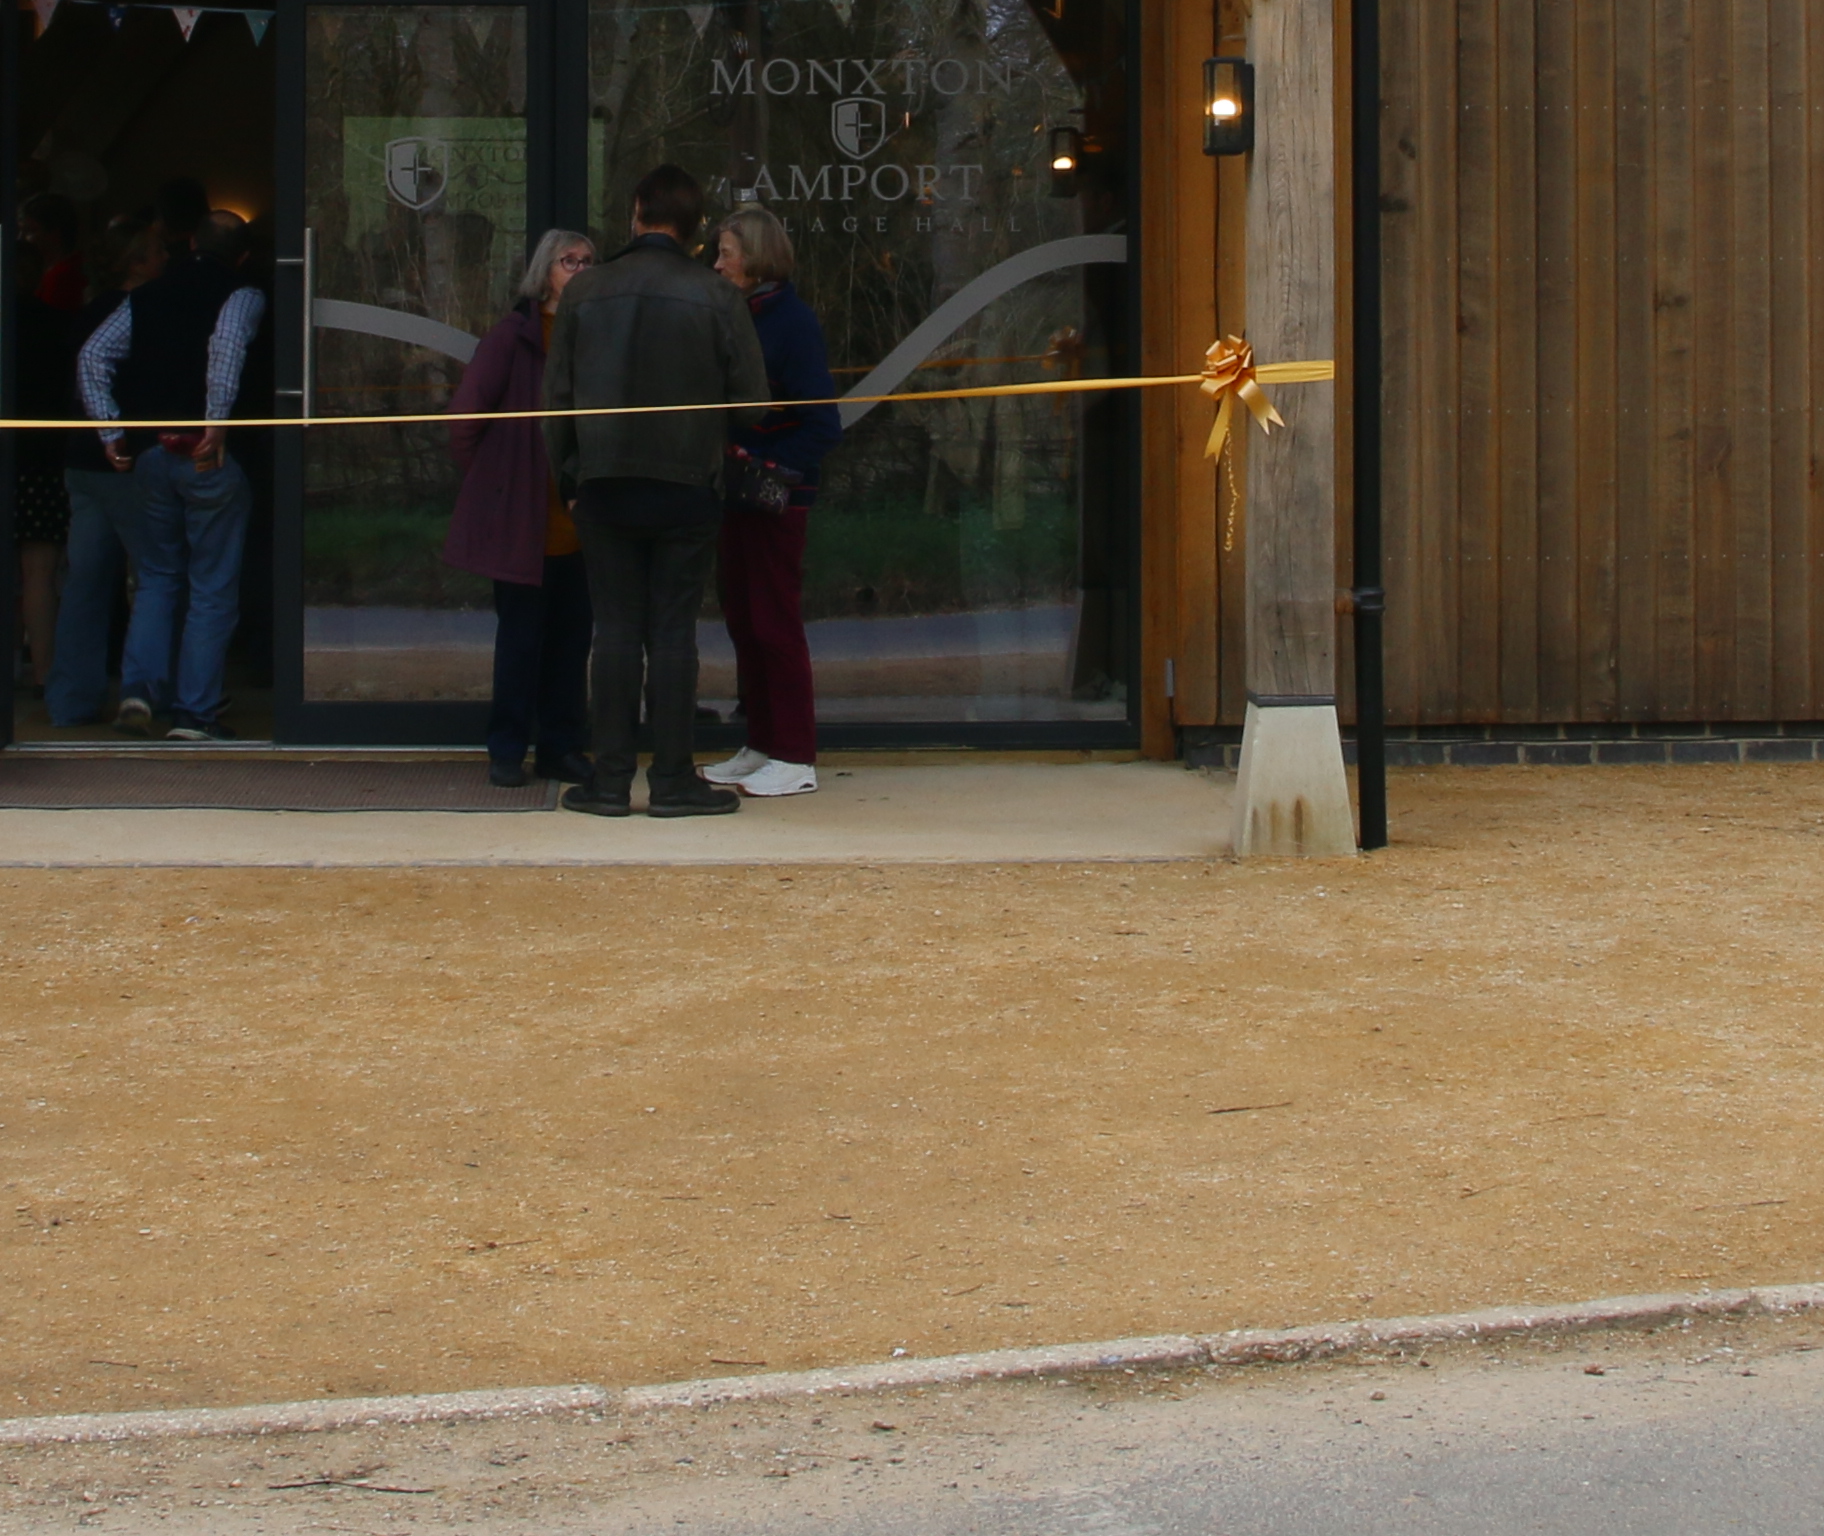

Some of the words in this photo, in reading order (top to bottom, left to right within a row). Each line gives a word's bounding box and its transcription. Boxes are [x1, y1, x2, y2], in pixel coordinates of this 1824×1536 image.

[709, 58, 1016, 96] MONXTON
[753, 164, 983, 201] AMPORT
[698, 216, 888, 233] VLAGE
[916, 216, 1021, 233] HALL
